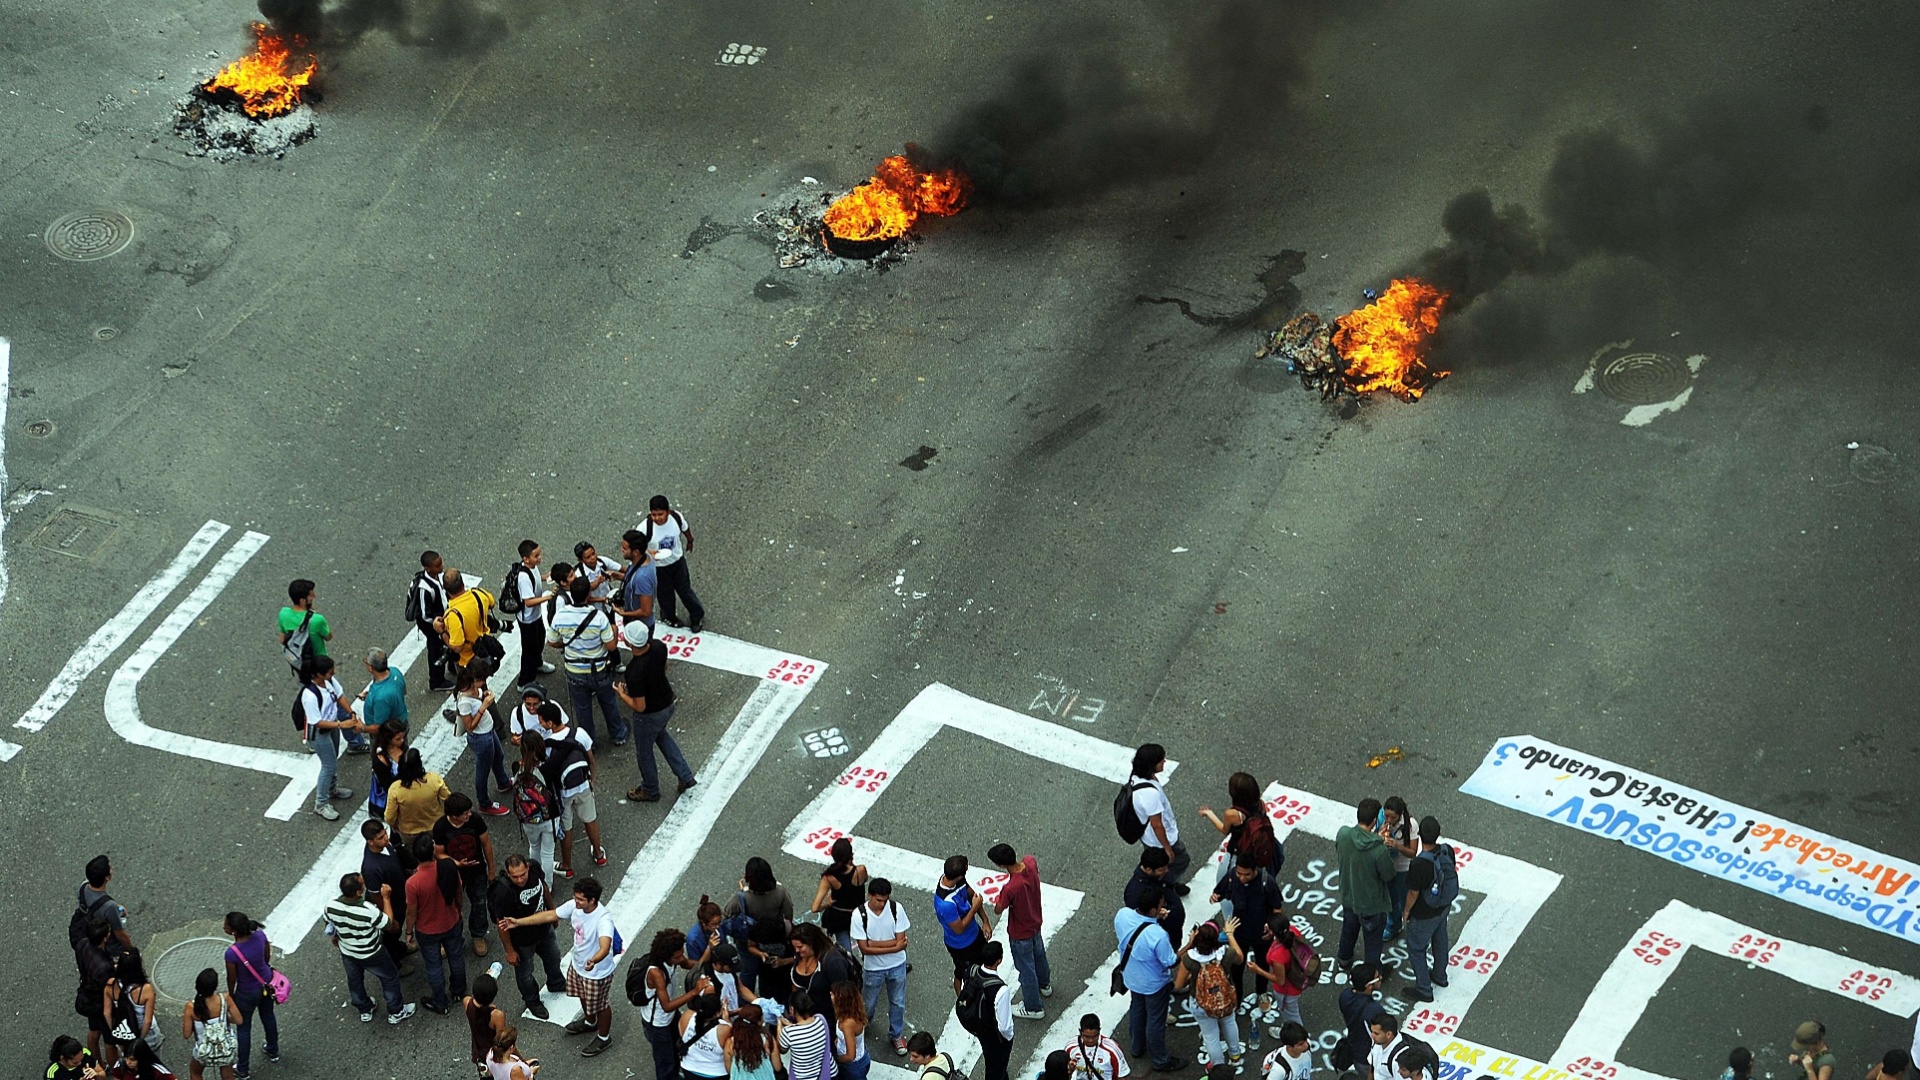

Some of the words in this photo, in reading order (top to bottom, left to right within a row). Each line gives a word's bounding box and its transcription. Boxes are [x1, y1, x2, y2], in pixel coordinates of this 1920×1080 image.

[720, 53, 760, 65] UCV
[725, 42, 768, 57] SOS
[668, 645, 695, 658] SO
[767, 668, 809, 685] SOS
[820, 727, 849, 756] SOS
[838, 774, 881, 793] SOS
[1273, 795, 1311, 815] UCV
[1632, 930, 1665, 958] UCV
[1643, 937, 1682, 966] SOS
[1738, 934, 1782, 952] UCV
[1457, 945, 1500, 962] UCV
[1728, 943, 1776, 964] SOS
[1448, 954, 1494, 975] SOS
[1850, 970, 1893, 989] UCV
[1838, 979, 1886, 1001] SOS
[1416, 1009, 1459, 1027] UCV
[1439, 1041, 1486, 1067] POR
[1488, 1056, 1520, 1077] EL
[1577, 1056, 1618, 1078] UCV
